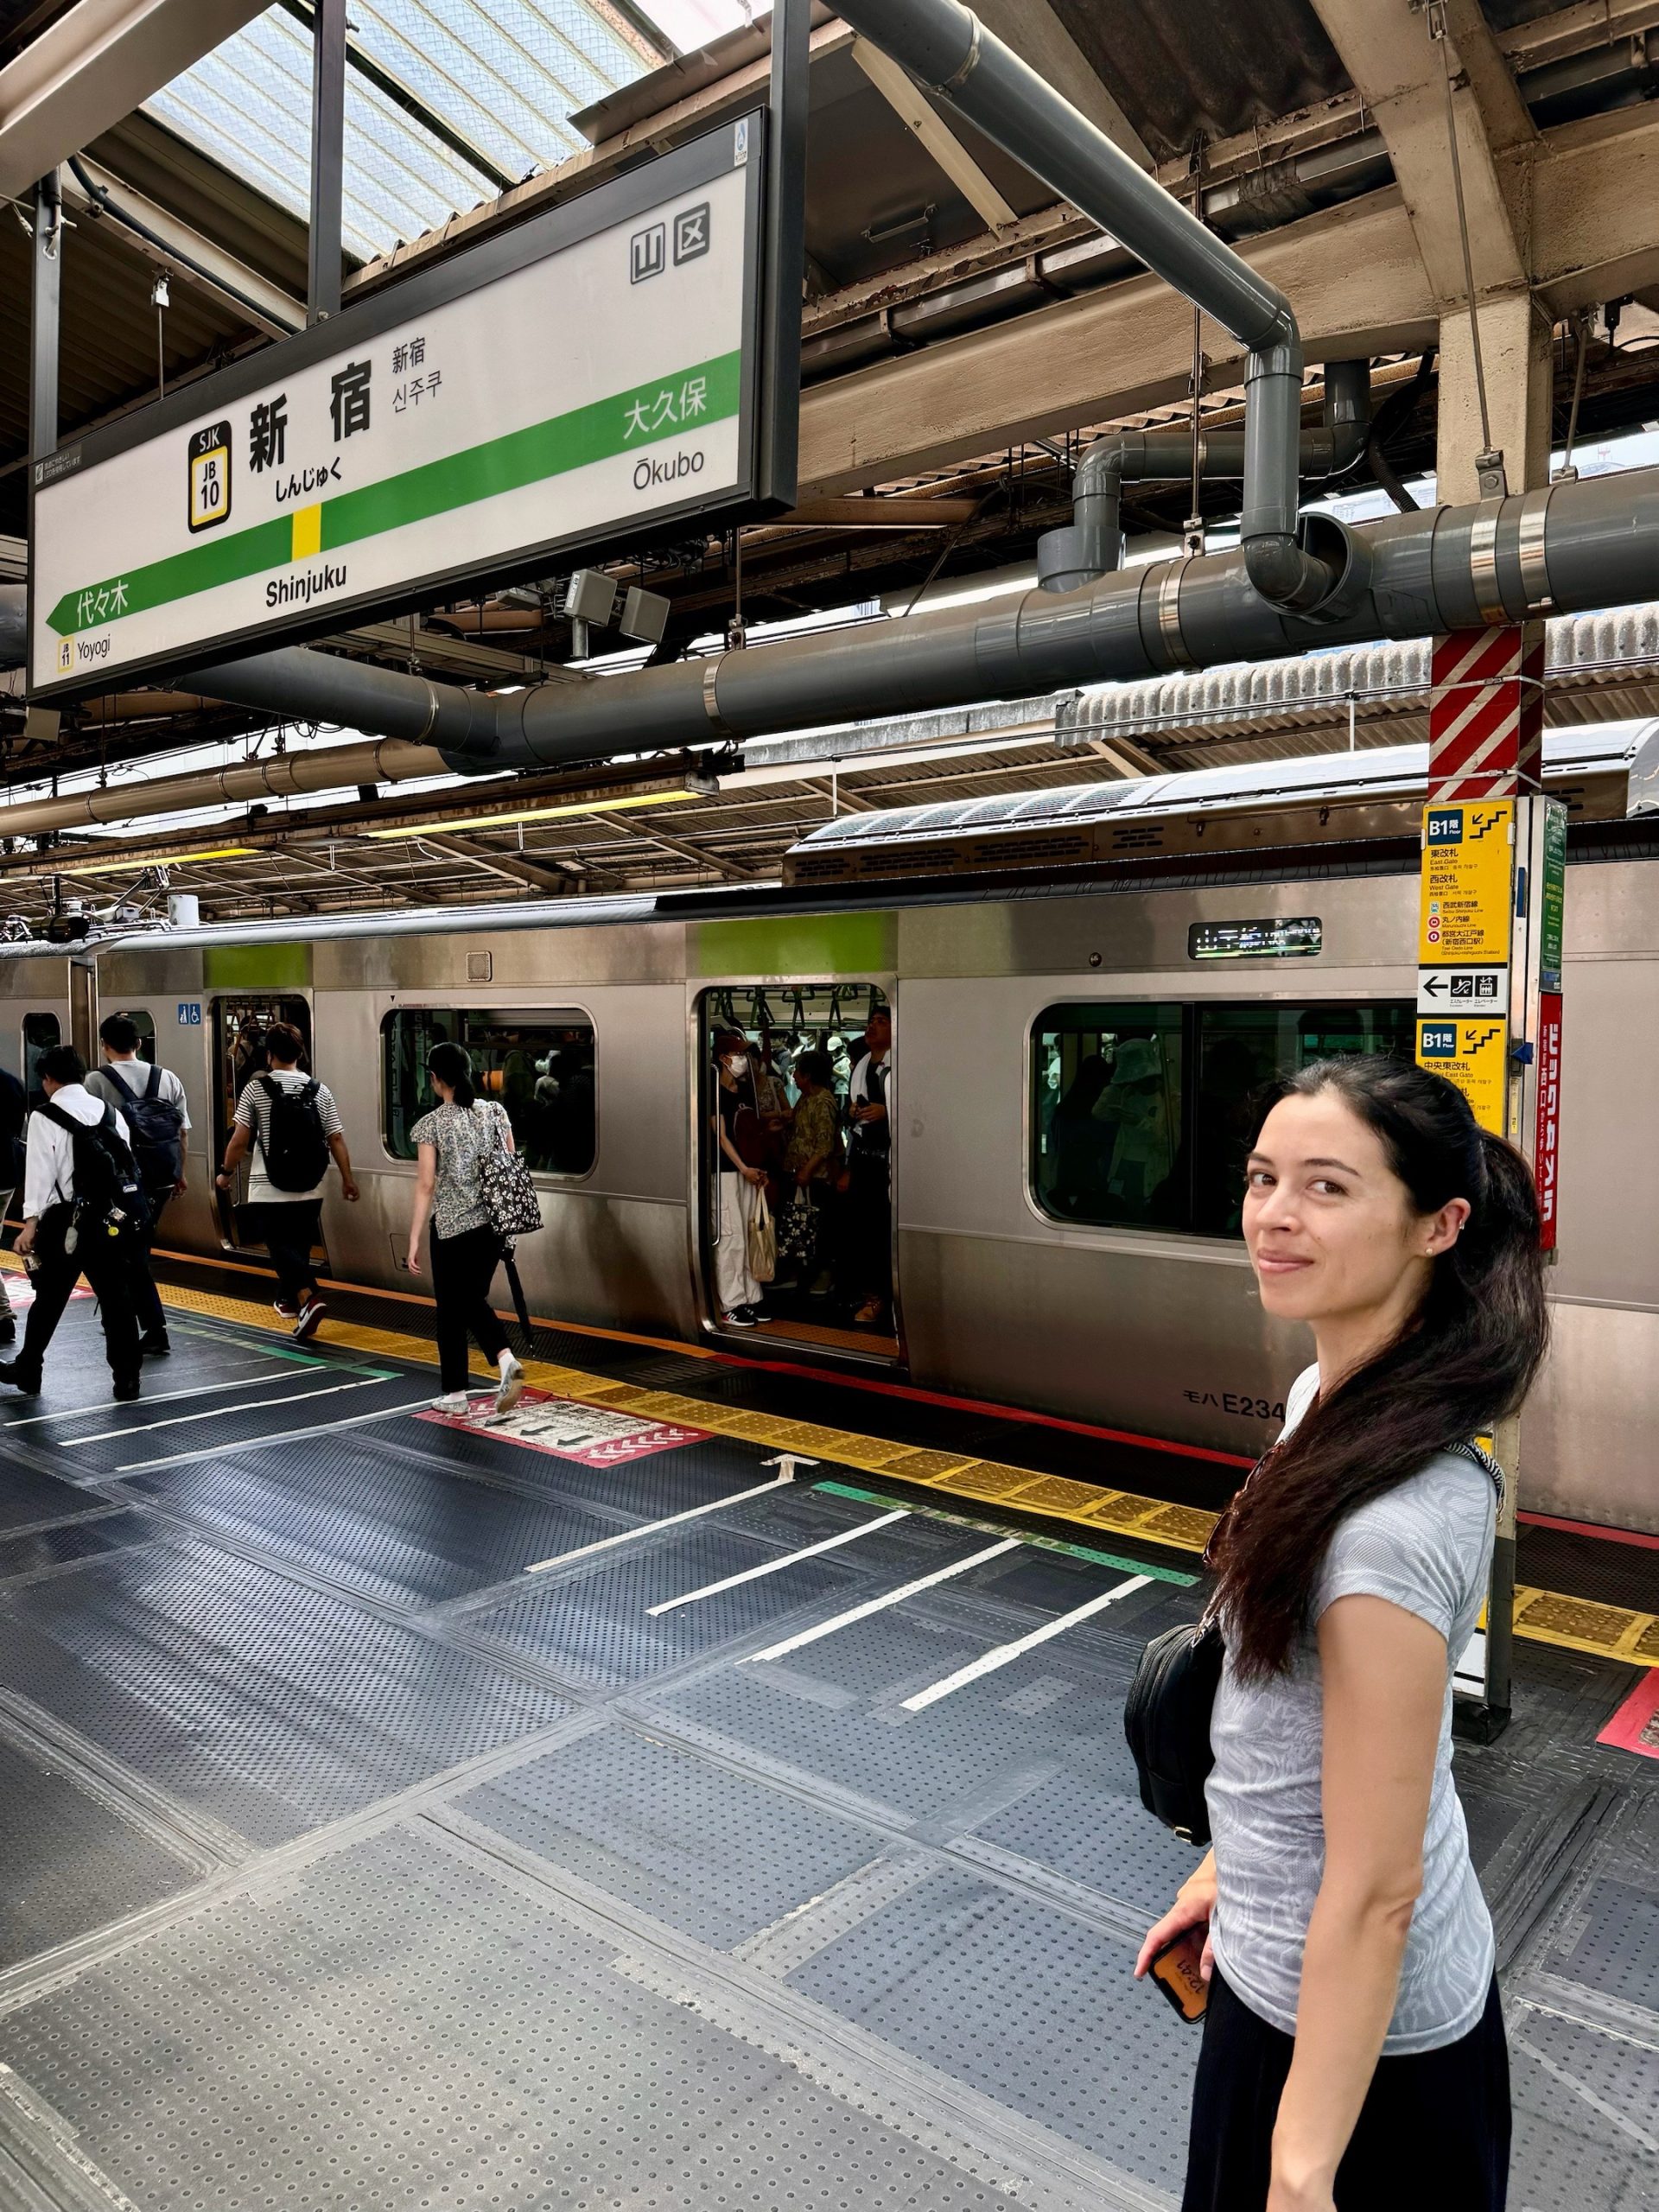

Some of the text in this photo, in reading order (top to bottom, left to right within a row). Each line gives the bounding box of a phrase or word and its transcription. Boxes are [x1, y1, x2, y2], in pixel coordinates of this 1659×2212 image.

[391, 337, 426, 374] 新宿
[391, 369, 442, 414] 신주쿠
[250, 359, 372, 474] 新宿
[622, 375, 707, 440] 大久保
[199, 427, 221, 453] SJK
[203, 461, 216, 482] JB
[276, 456, 342, 502] しんじゅく
[632, 449, 704, 491] Ōkubo
[201, 480, 219, 510] 10
[266, 564, 346, 607] Shinjuku
[77, 579, 129, 627] 代々木
[62, 652, 69, 666] 11
[63, 643, 69, 653] JB
[78, 633, 111, 661] Yoyogi
[1429, 819, 1459, 836] B1階
[1431, 848, 1459, 858] 東改札
[1430, 874, 1459, 883] 西改札
[1423, 1033, 1452, 1048] B1階
[1424, 1061, 1471, 1071] 中央東改札
[1177, 1959, 1205, 1994] 12:41
